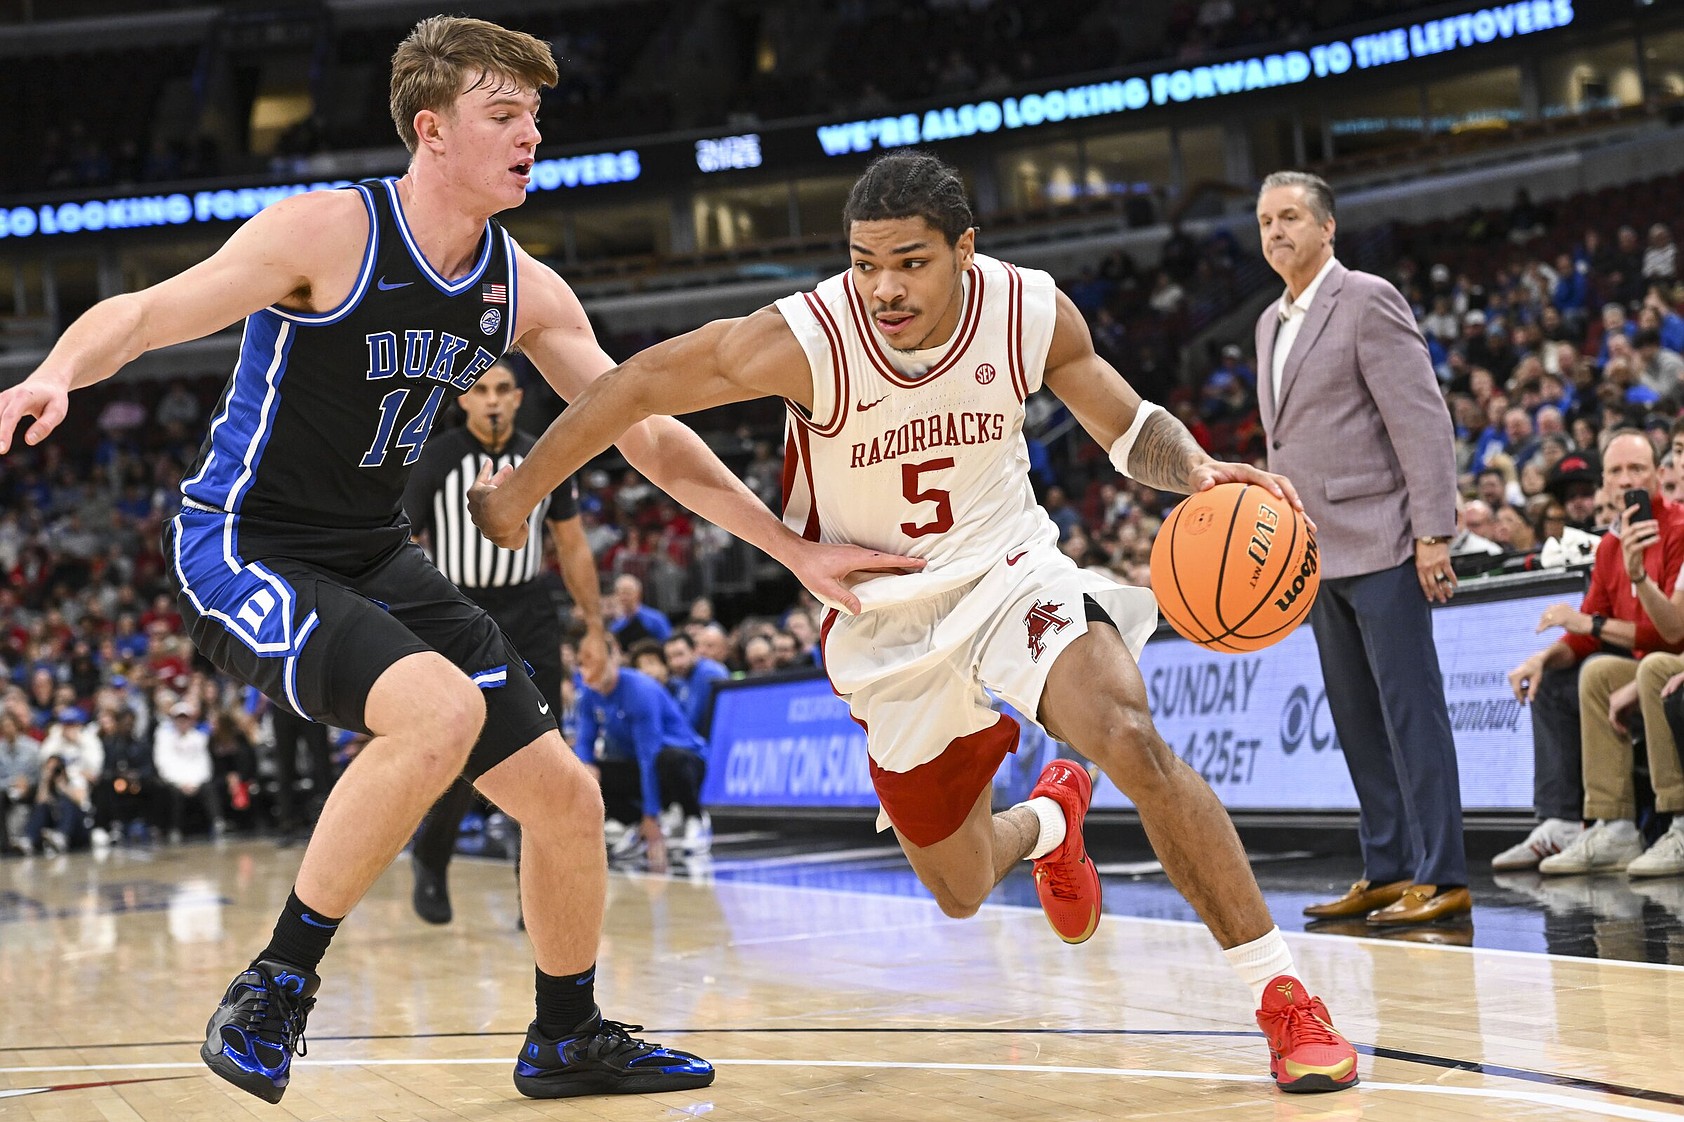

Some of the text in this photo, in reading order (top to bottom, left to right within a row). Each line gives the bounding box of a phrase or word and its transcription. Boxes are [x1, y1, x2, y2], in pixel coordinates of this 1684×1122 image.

[921, 101, 1002, 142] ALSO
[1003, 78, 1149, 129] LOOKING
[1151, 50, 1312, 105] FORWARD
[1310, 41, 1352, 78] TO
[1352, 28, 1410, 69] THE
[1410, 0, 1575, 57] LEFTOVERS
[39, 193, 192, 235] LOOKING
[366, 329, 497, 391] DUKE
[977, 366, 994, 385] SEC
[358, 385, 446, 467] 14
[850, 412, 1004, 468] RAZORBACKS
[900, 457, 955, 538] 5
[1247, 503, 1279, 567] EVO
[1250, 566, 1262, 590] NXT
[236, 588, 276, 636] D
[1150, 658, 1262, 719] SUNDAY
